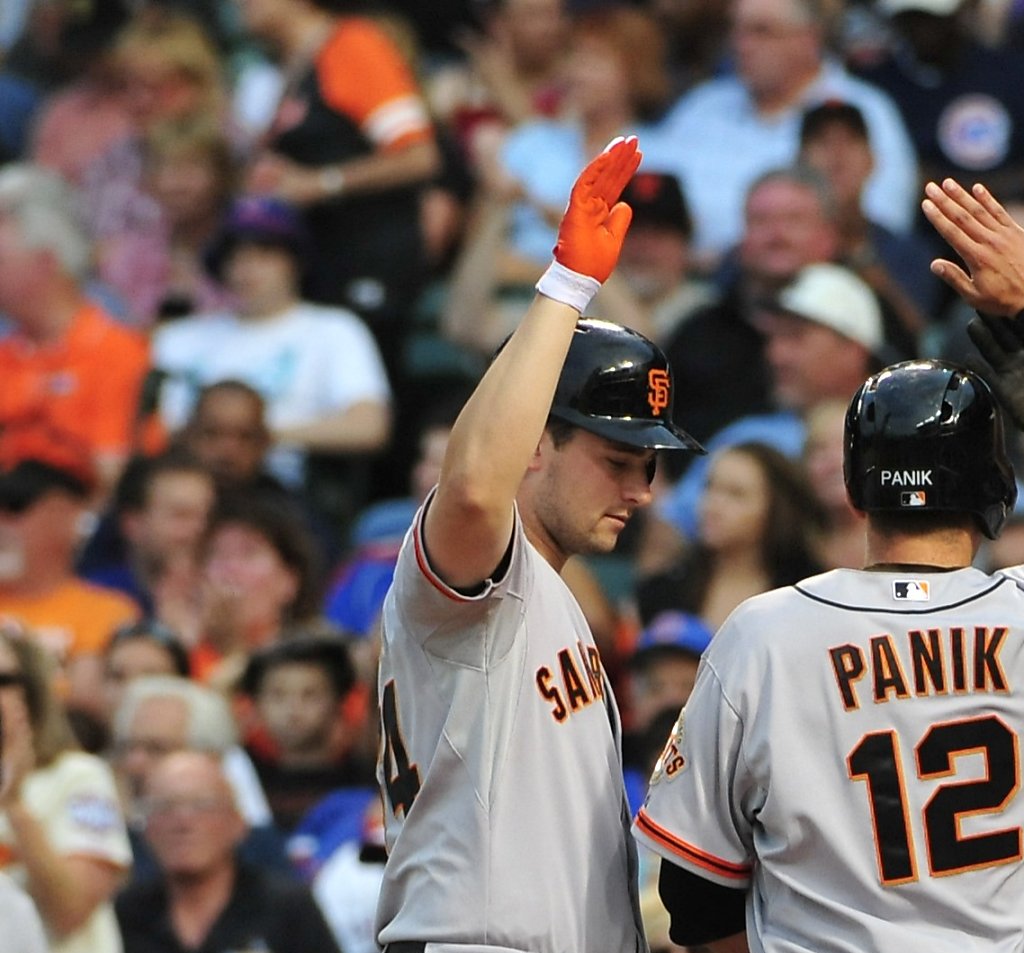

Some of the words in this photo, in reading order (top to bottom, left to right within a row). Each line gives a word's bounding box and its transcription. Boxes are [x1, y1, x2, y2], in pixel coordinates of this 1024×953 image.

[648, 368, 670, 416] SF
[881, 469, 933, 486] PANIK
[828, 626, 1011, 712] PANIK
[382, 678, 423, 820] 4
[846, 713, 1024, 886] 12
